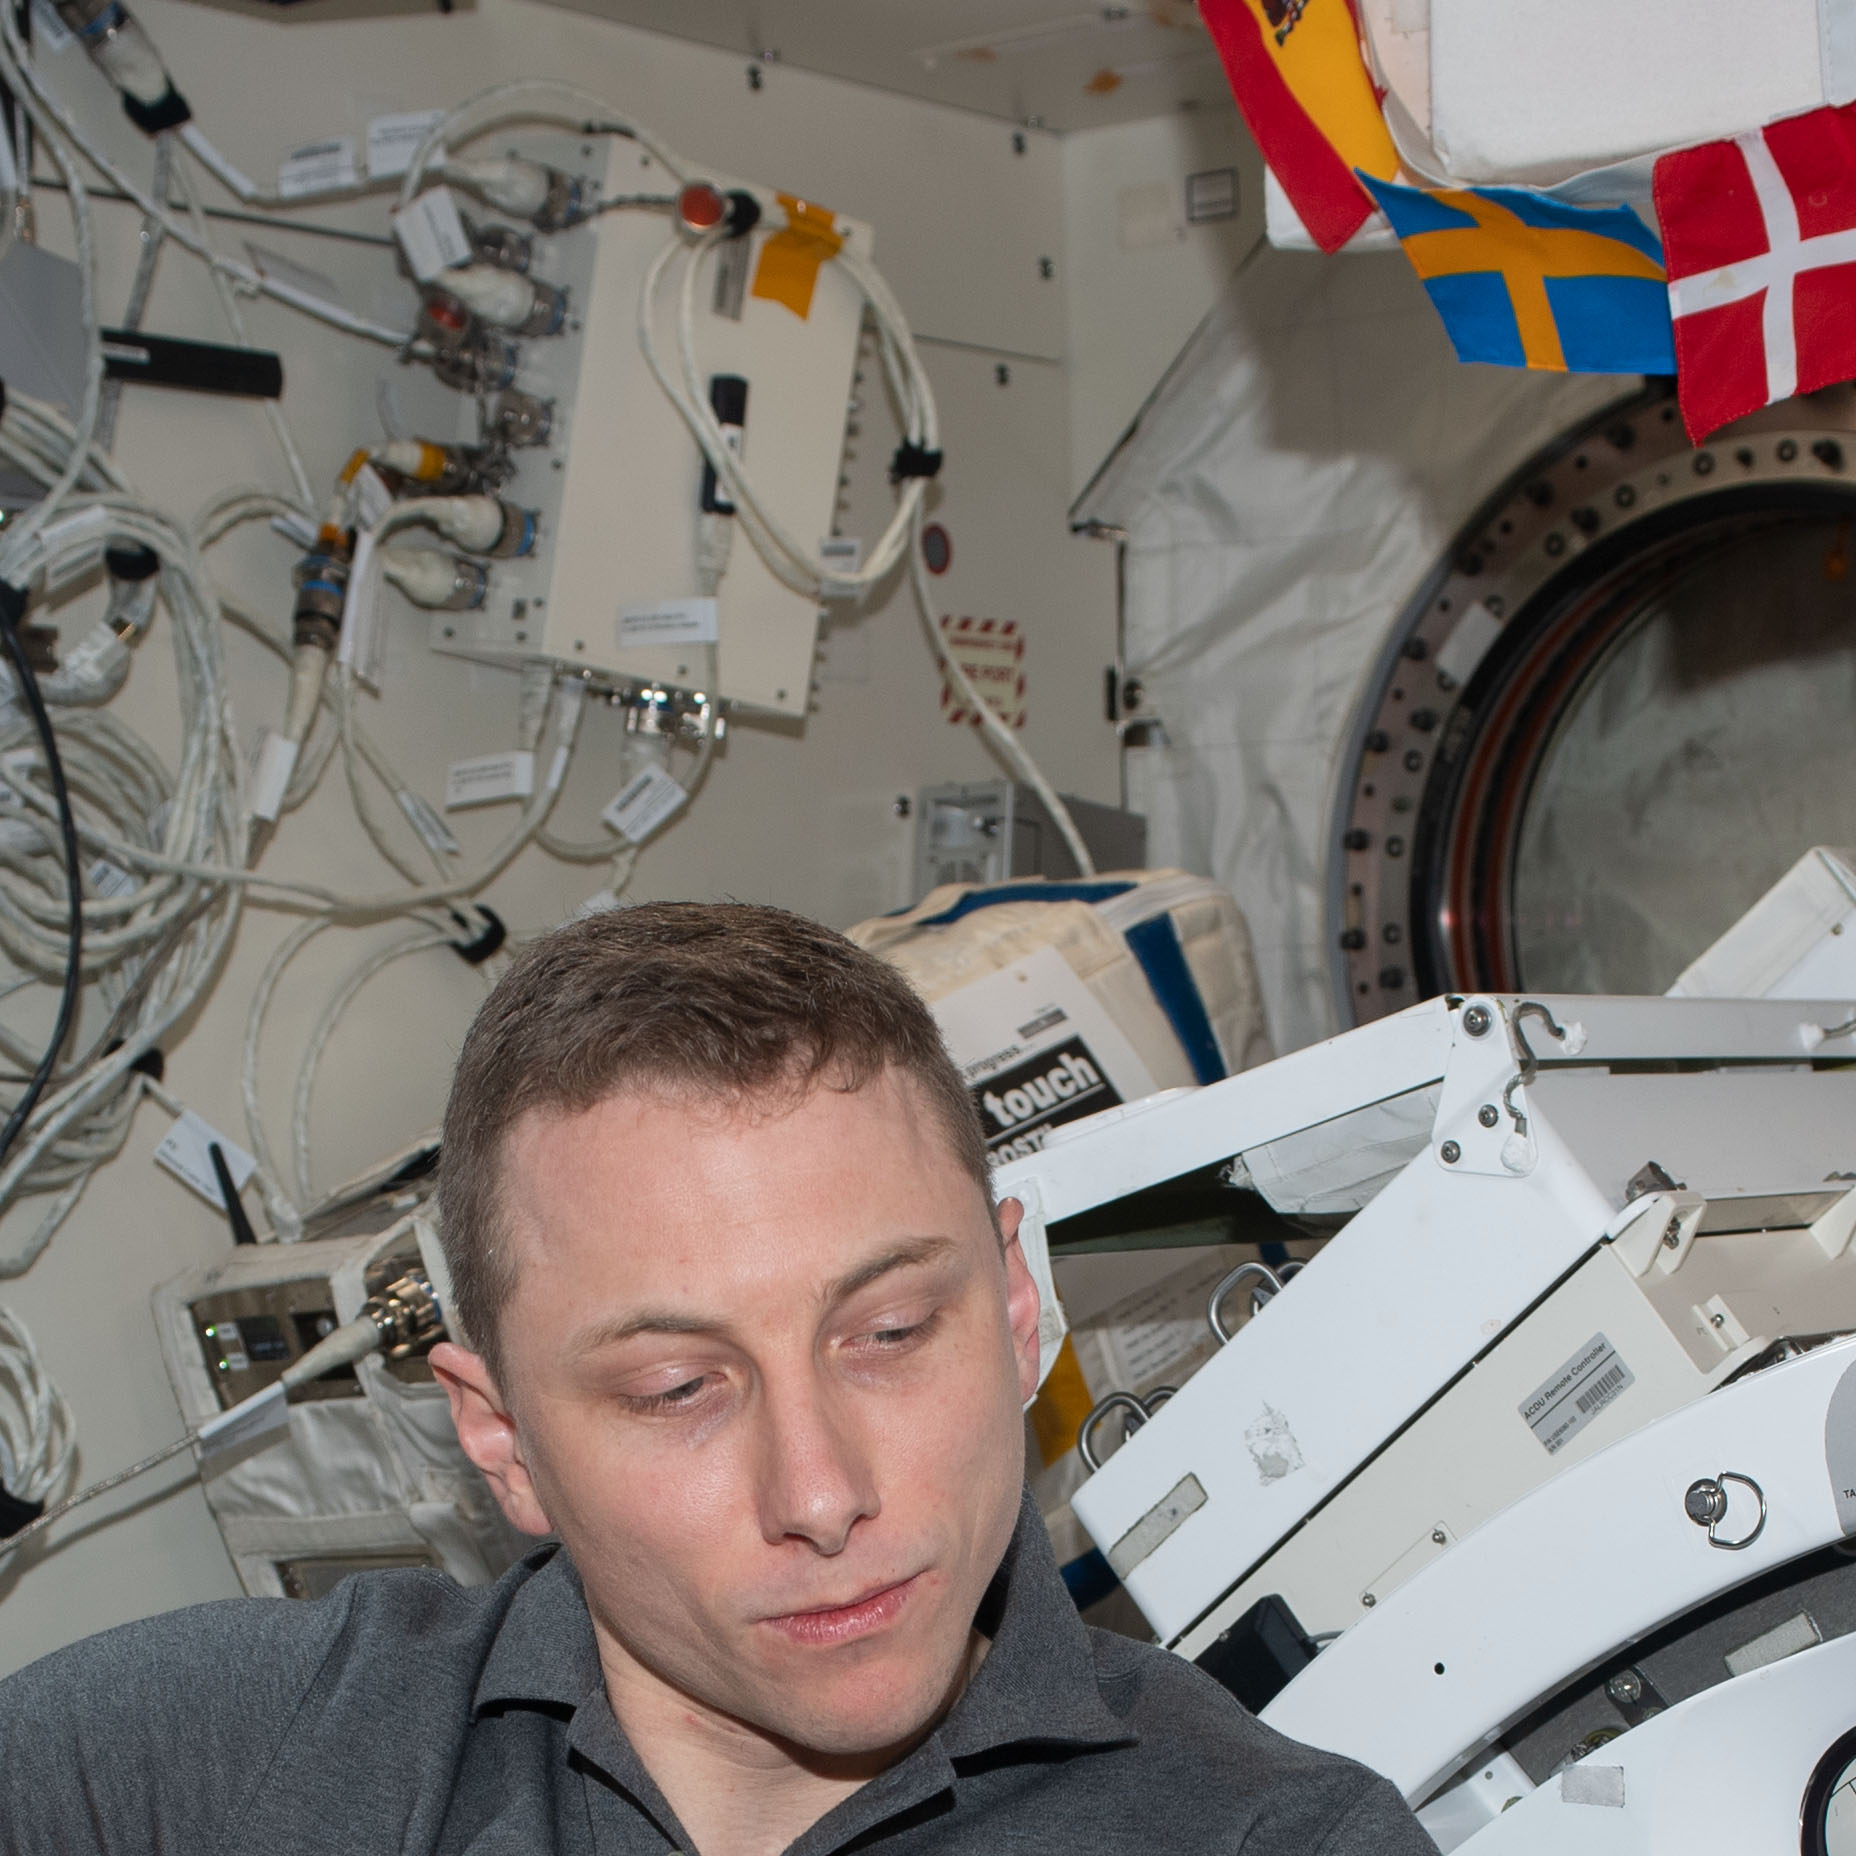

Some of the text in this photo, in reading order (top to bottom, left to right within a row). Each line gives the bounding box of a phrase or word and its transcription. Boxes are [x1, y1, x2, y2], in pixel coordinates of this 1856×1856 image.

[982, 1052, 1101, 1127] touch
[1524, 1397, 1546, 1420] ACDU
[1544, 1373, 1573, 1401] Remote
[1570, 1343, 1607, 1376] Controller
